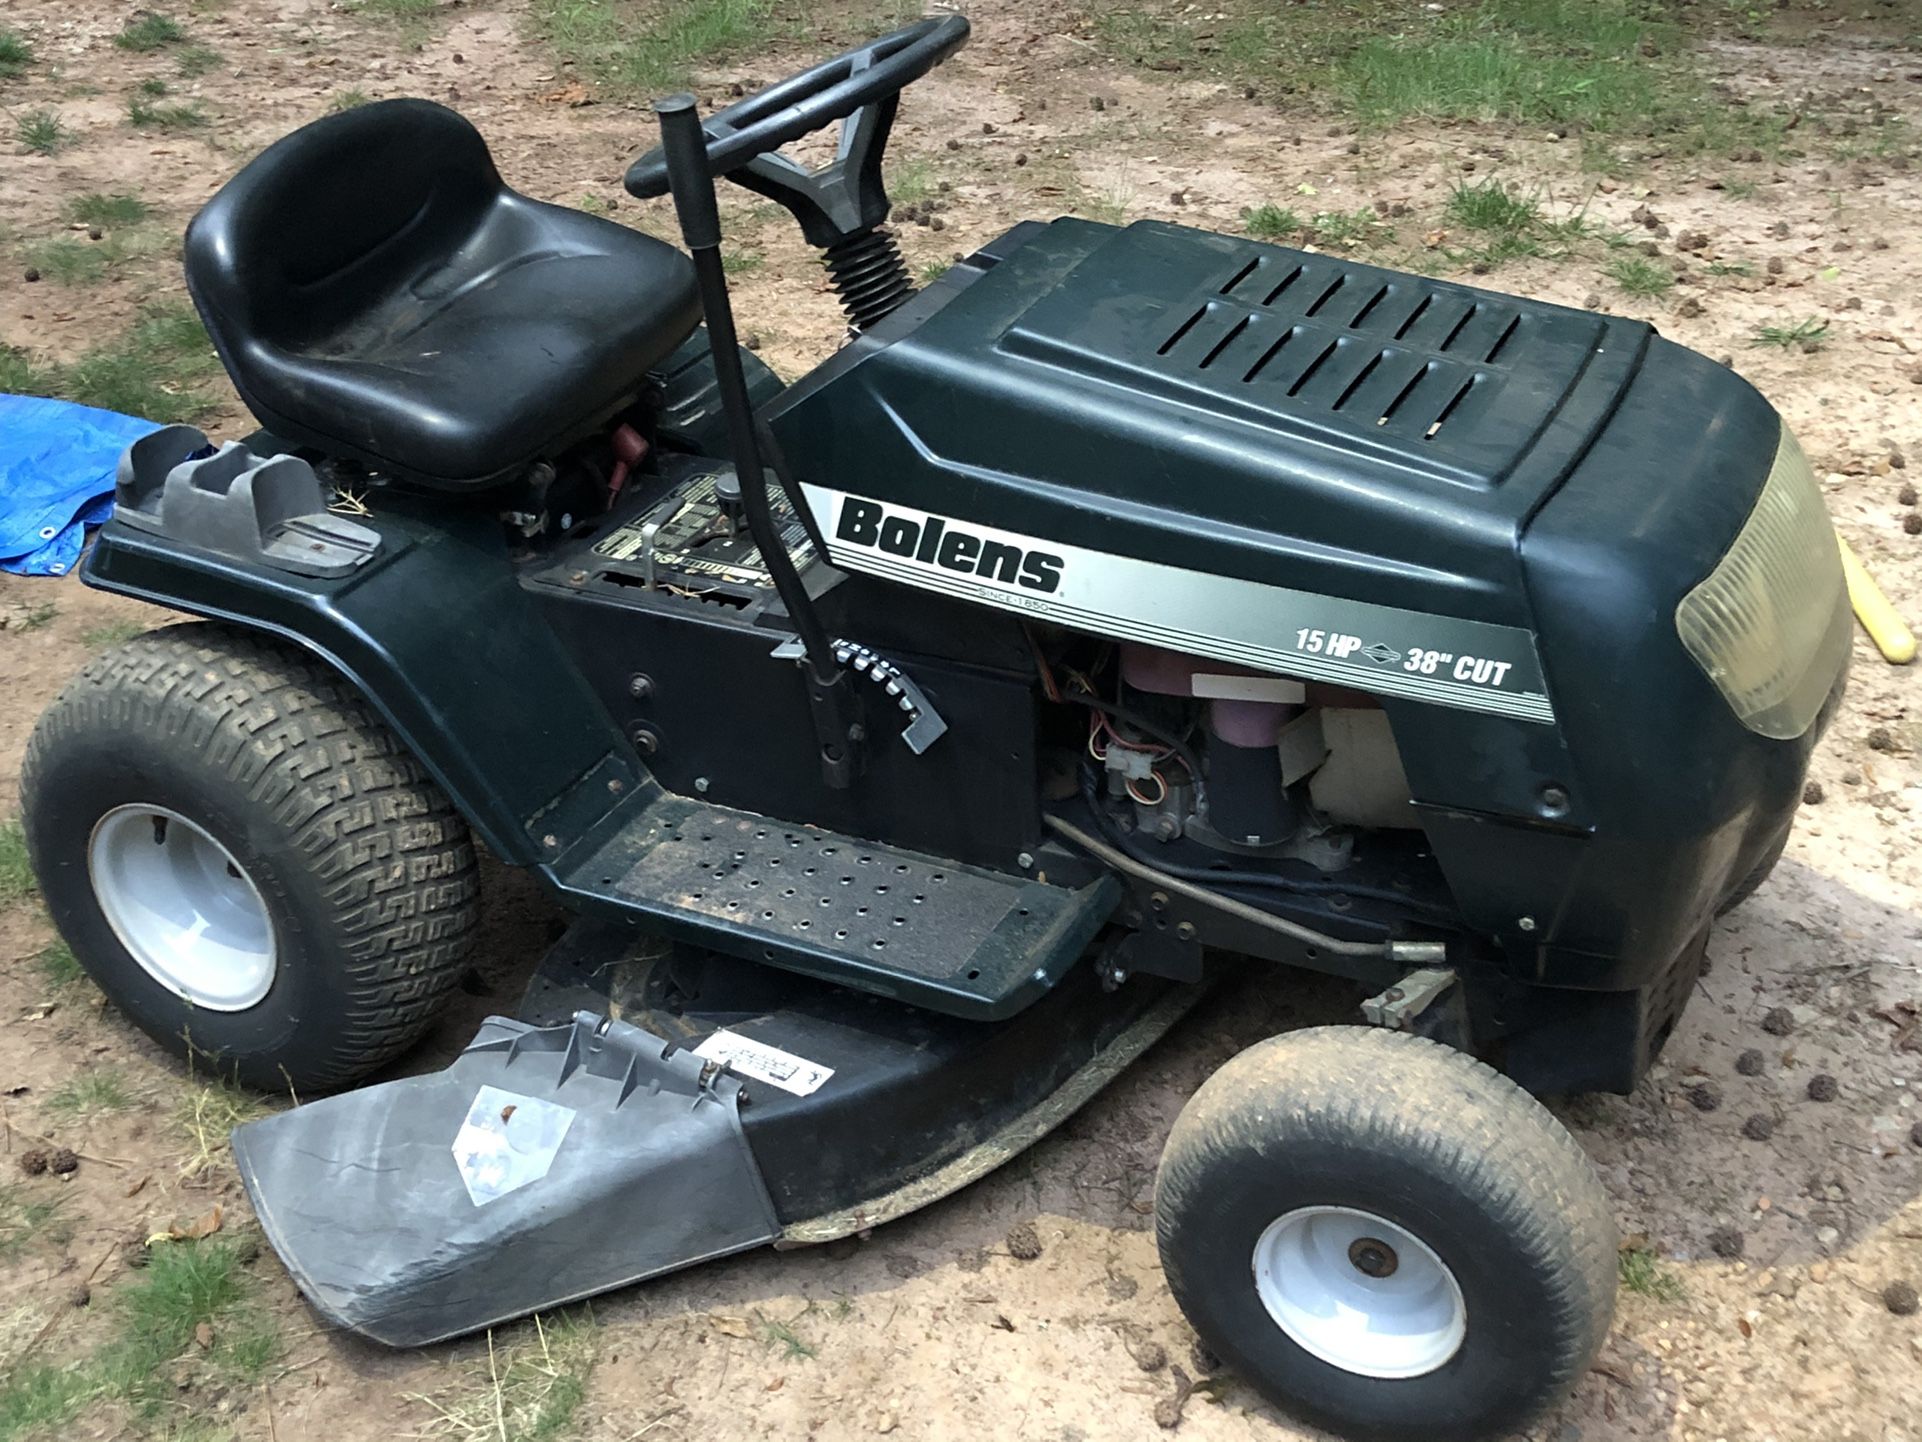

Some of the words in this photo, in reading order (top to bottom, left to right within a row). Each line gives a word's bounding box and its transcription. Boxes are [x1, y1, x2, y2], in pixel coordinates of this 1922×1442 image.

[836, 496, 1065, 594] Bolens
[1296, 628, 1325, 652] 15
[1326, 633, 1362, 659] HP
[1403, 648, 1453, 675] 38"
[1453, 656, 1512, 686] CUT
